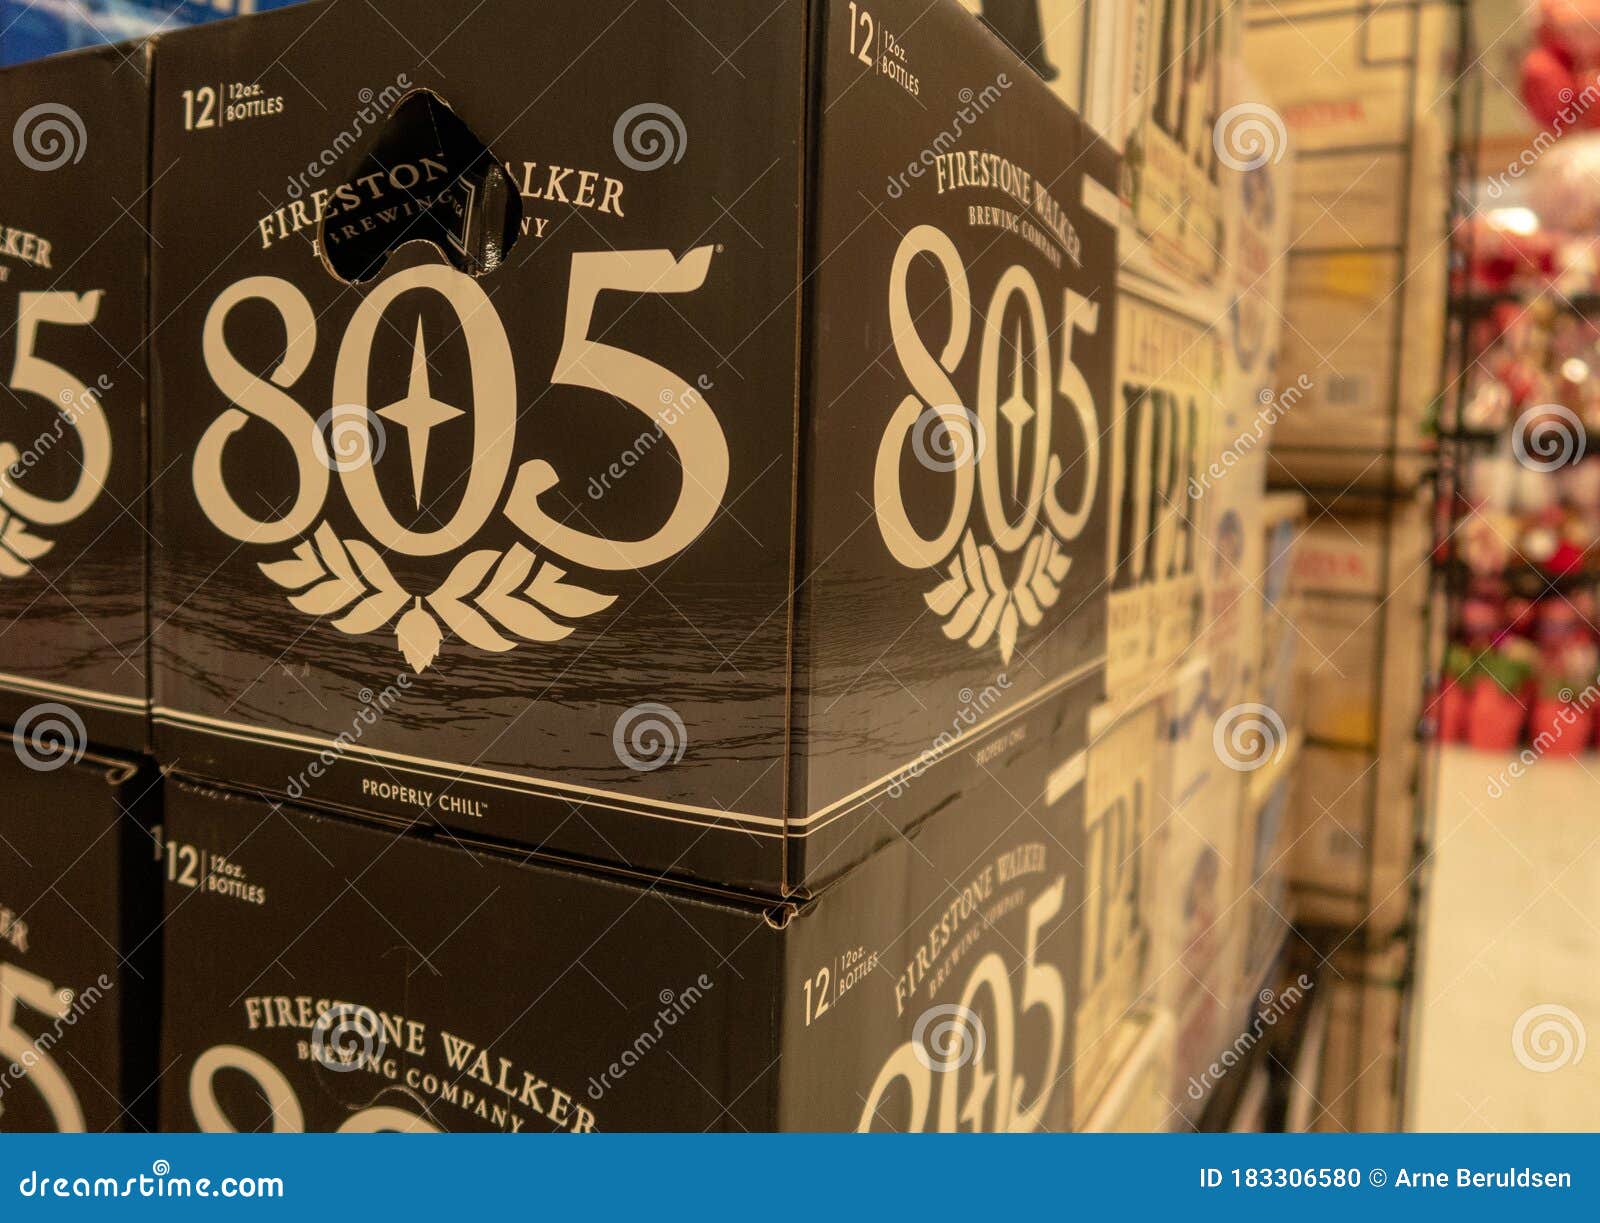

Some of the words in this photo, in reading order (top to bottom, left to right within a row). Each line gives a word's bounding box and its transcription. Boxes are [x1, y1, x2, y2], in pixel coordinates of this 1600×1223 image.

[848, 2, 874, 67] 12
[228, 82, 264, 100] 12oz.
[881, 55, 920, 96] BOTTLES
[181, 86, 216, 131] 12
[226, 95, 284, 122] BOTTLES
[257, 152, 449, 249] FIRESTON
[504, 160, 625, 218] LKER
[935, 150, 1031, 206] FIRESTONE
[968, 205, 1020, 235] BREWING
[874, 224, 1100, 569] 805
[361, 778, 433, 809] PROPERLY
[165, 840, 200, 889] 12
[207, 875, 266, 905] BOTTLES
[895, 864, 994, 1018] FIRESTONE
[803, 966, 830, 1028] 12
[838, 951, 879, 998] BOTTLES
[244, 995, 427, 1057] FIRESTONE
[440, 1030, 596, 1133] WALKER
[296, 1039, 398, 1080] BREWING
[405, 1066, 525, 1133] COMPANY
